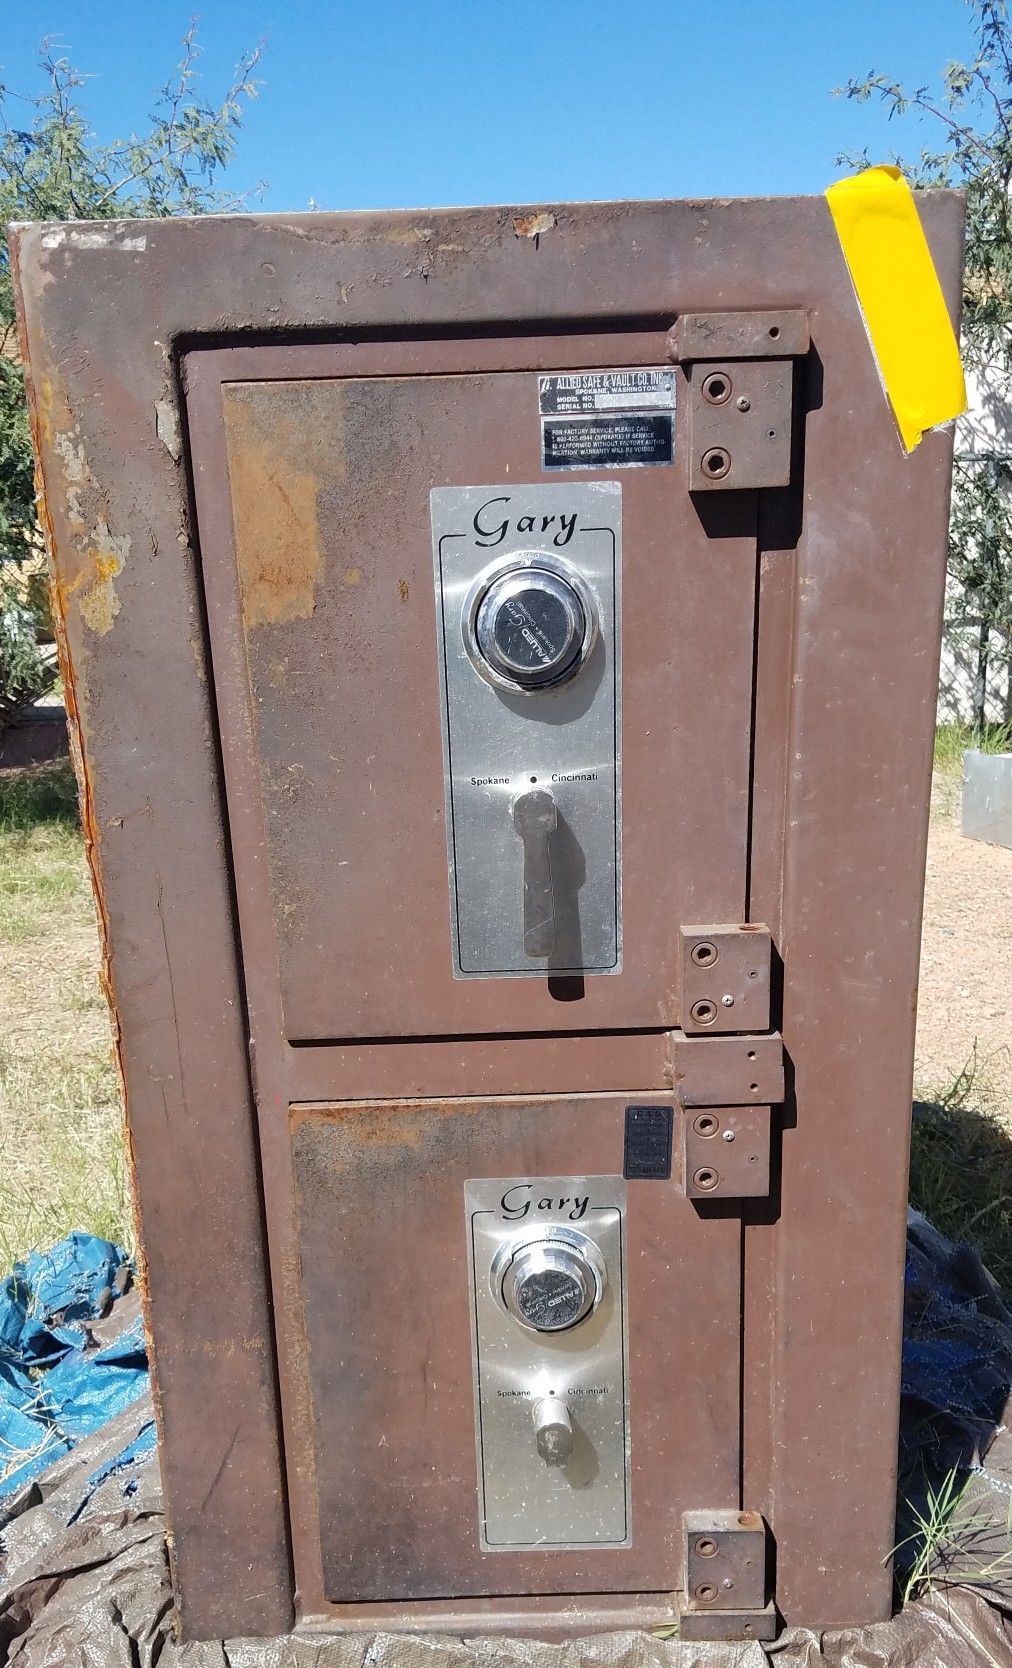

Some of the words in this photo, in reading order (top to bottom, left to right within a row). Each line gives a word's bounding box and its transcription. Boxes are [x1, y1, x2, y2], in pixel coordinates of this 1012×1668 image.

[556, 376, 581, 389] ALLIED
[582, 375, 602, 388] SAFE
[602, 374, 610, 387] &
[611, 373, 636, 386] VAULT
[580, 447, 610, 455] WARRANTY
[473, 497, 578, 547] Gary
[504, 601, 526, 626] Gary
[521, 627, 546, 657] ALLIED
[470, 777, 510, 786] Spokane
[551, 772, 598, 782] Cincinnati
[500, 1184, 590, 1220] Gary
[496, 1390, 531, 1398] Spokane
[567, 1387, 609, 1395] Cincinnati
